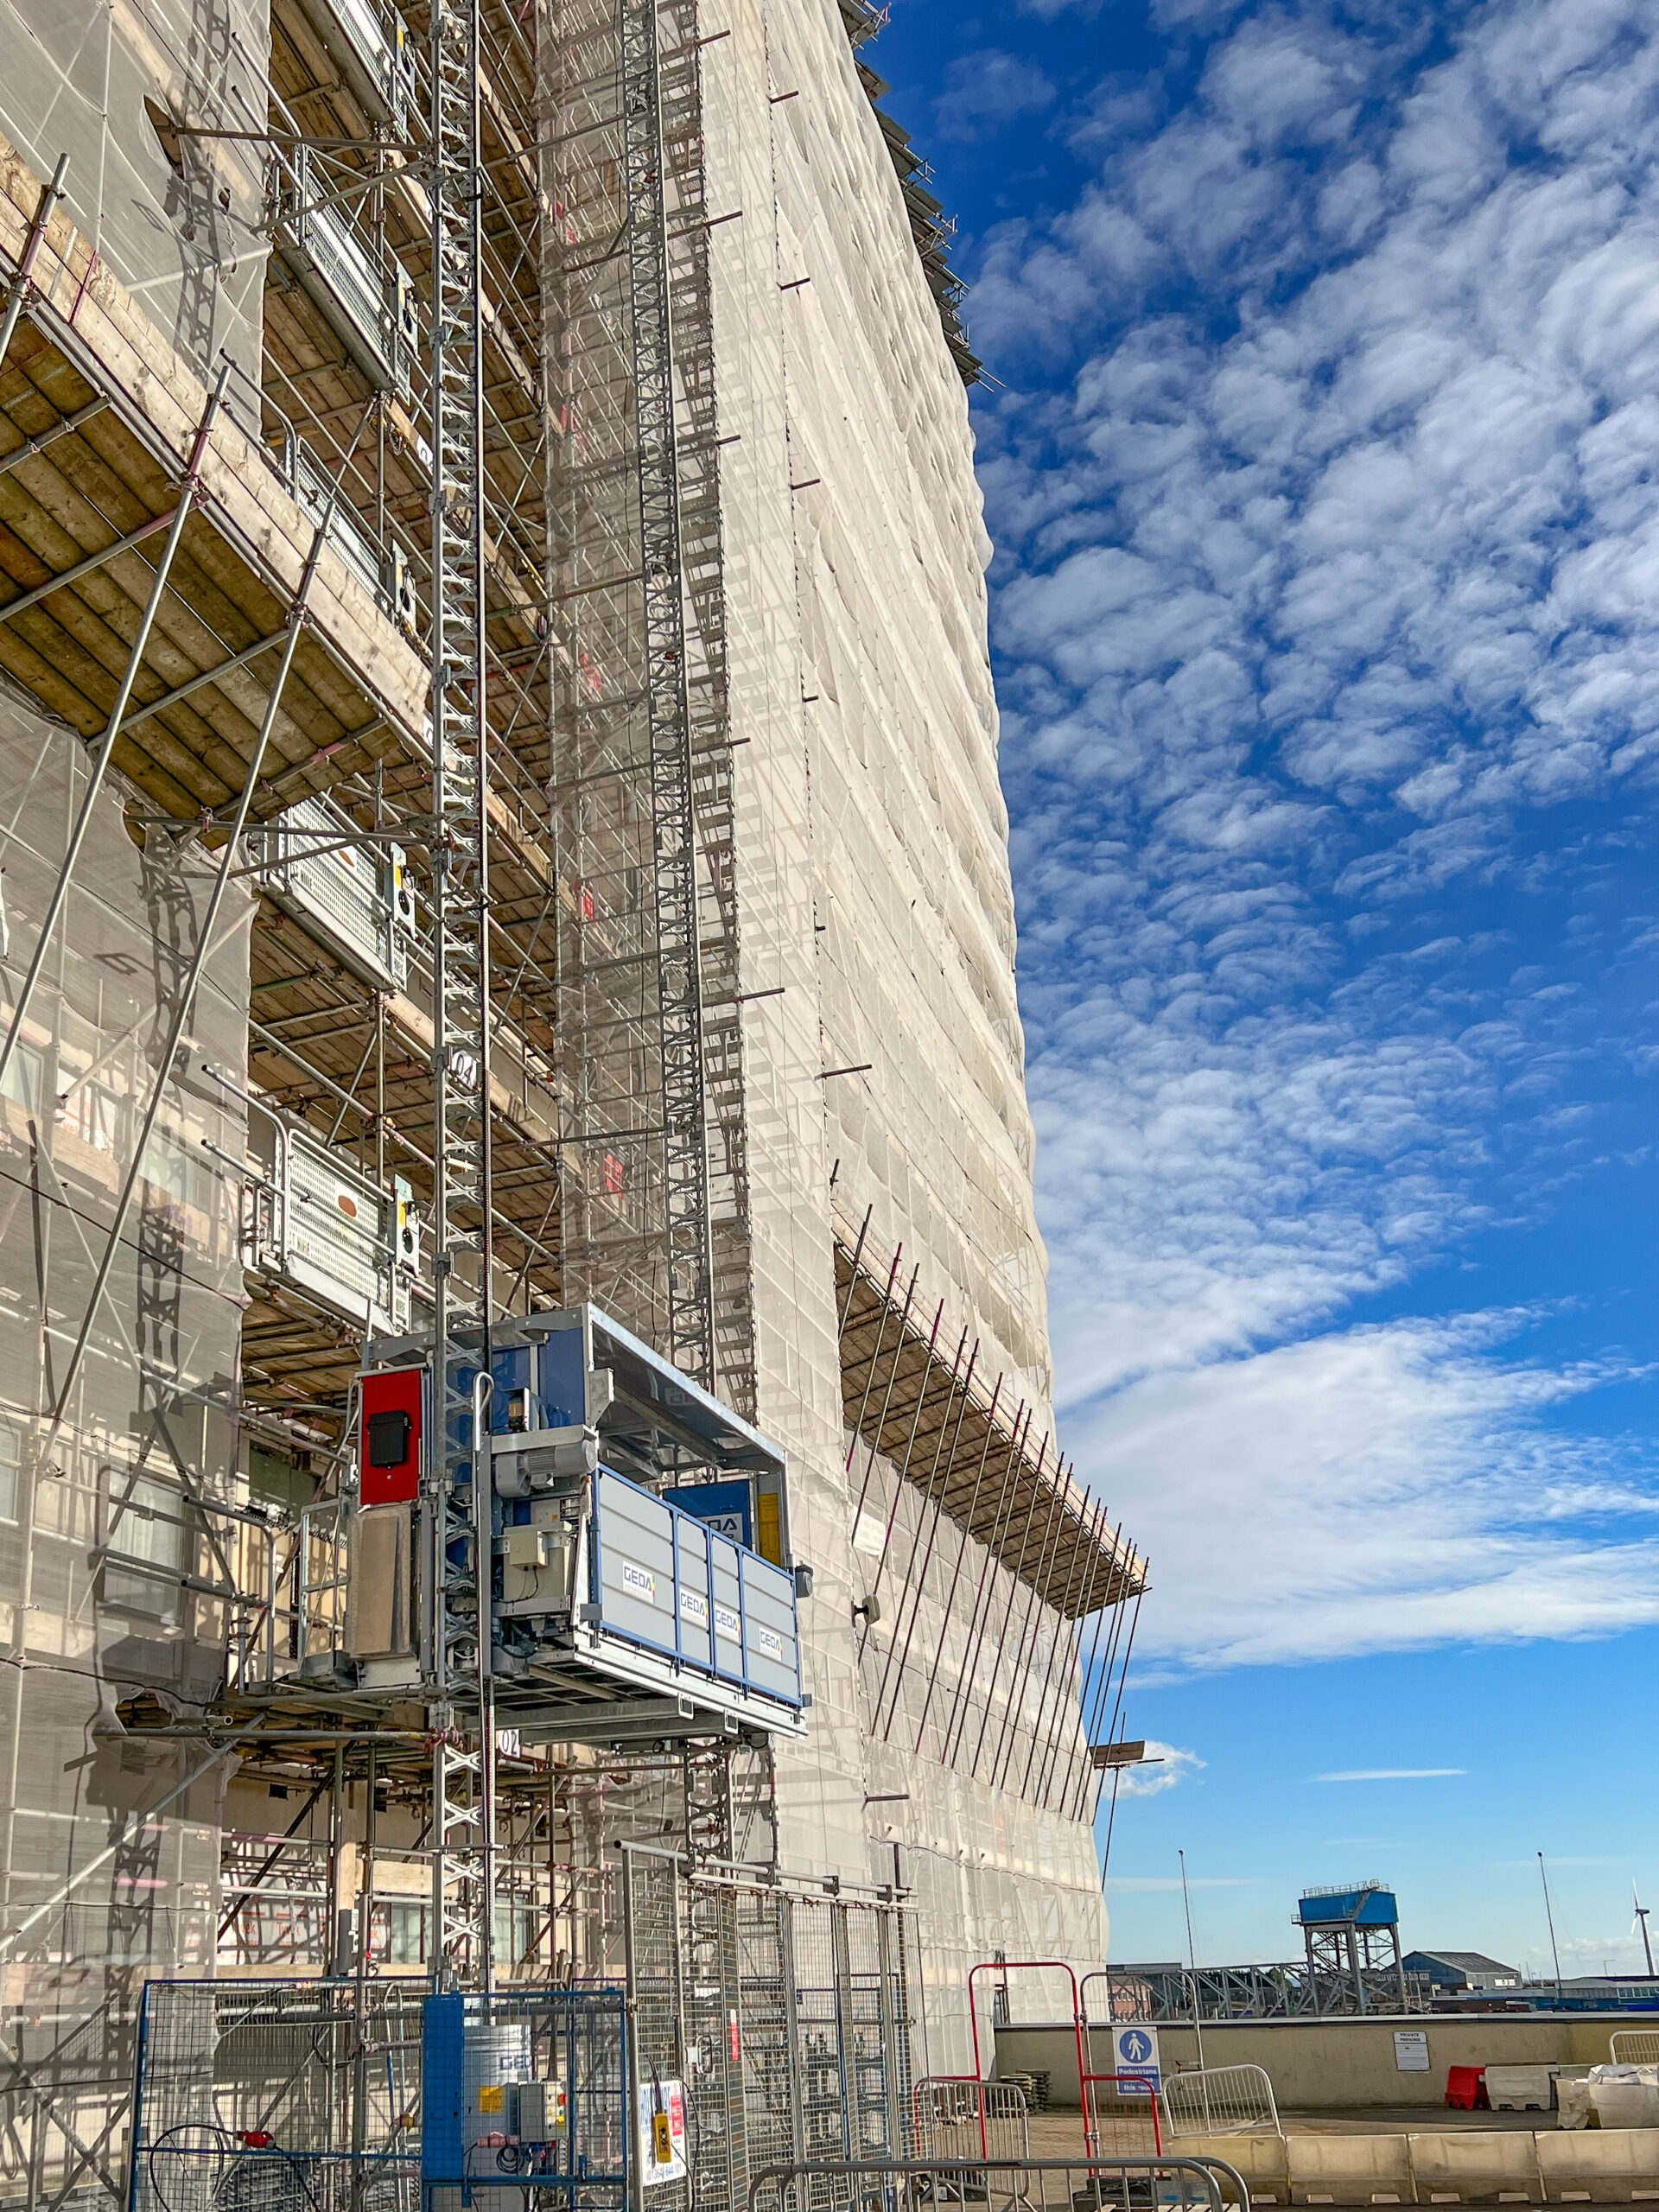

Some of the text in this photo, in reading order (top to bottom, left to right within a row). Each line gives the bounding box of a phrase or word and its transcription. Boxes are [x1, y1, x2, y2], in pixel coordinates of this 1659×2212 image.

[624, 1565, 652, 1592] GEDA
[681, 1592, 705, 1616] GEDA
[715, 1609, 738, 1630] GEDA
[760, 1630, 780, 1650] GEDA
[502, 1729, 518, 1755] 02
